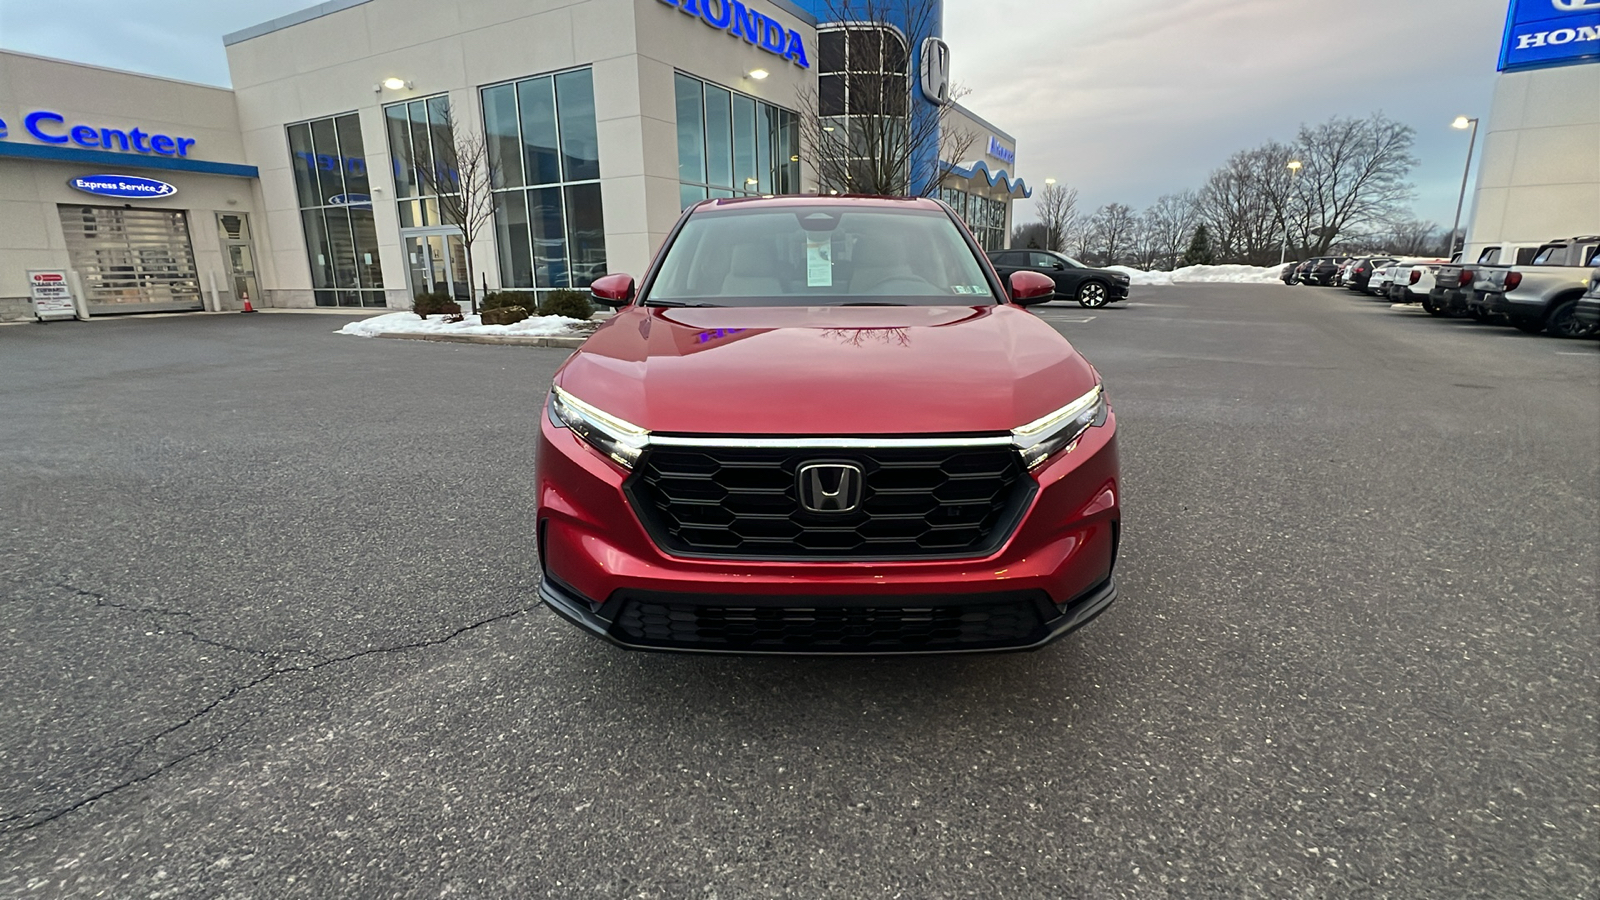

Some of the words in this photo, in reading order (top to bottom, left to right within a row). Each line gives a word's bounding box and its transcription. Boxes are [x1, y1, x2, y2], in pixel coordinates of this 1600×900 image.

[24, 110, 196, 157] Center
[76, 179, 118, 191] Express
[118, 182, 157, 193] Service
